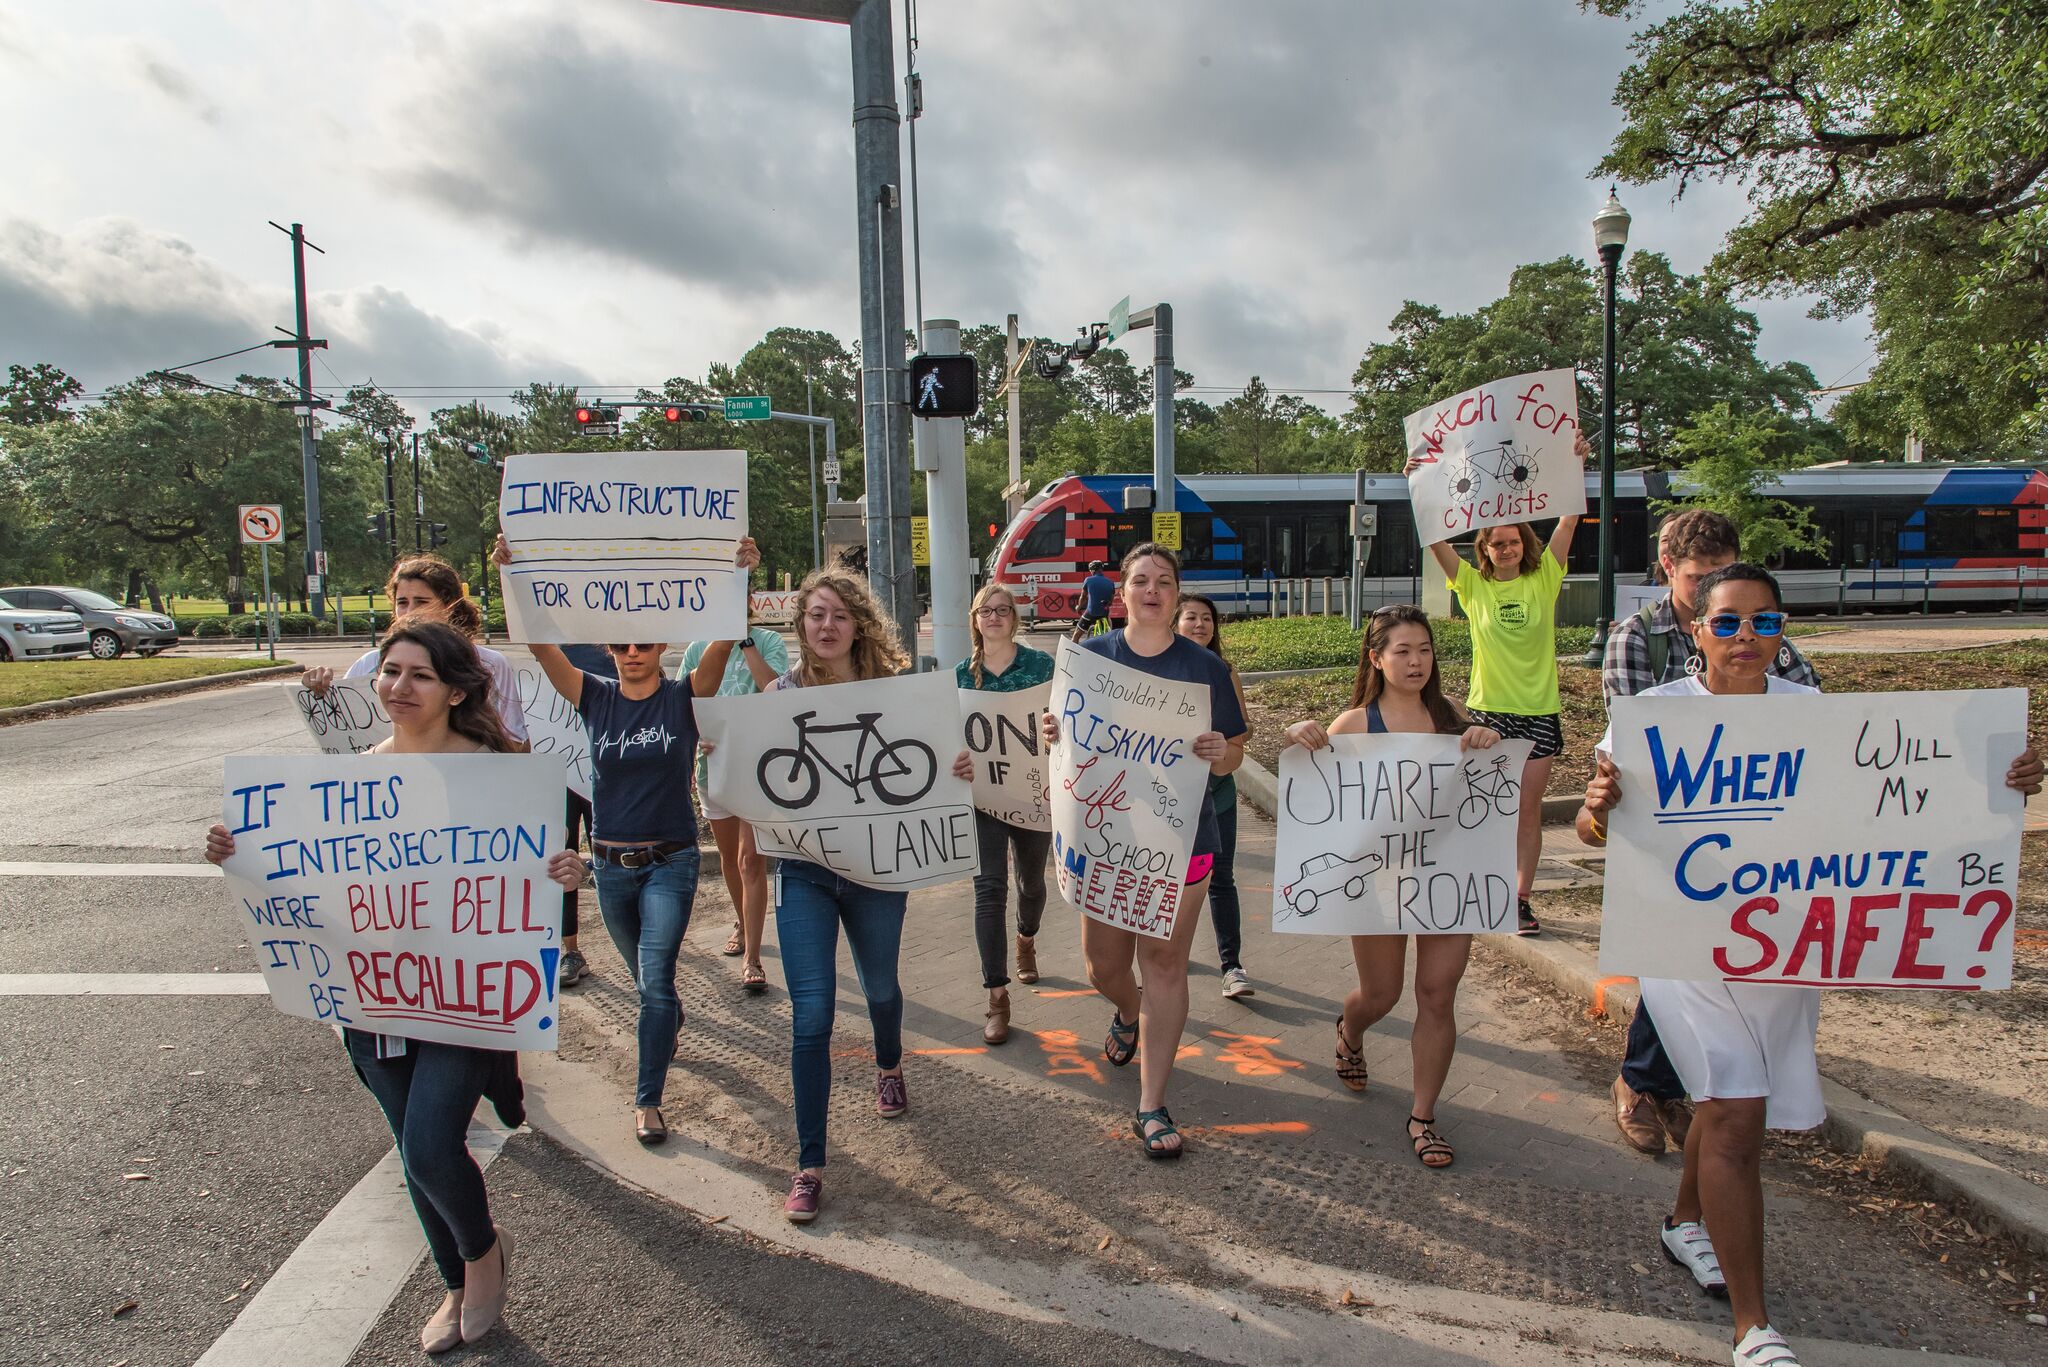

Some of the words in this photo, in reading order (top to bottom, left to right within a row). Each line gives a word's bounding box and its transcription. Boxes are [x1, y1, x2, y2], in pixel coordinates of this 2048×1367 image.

[727, 401, 753, 409] Fannin
[1516, 383, 1576, 435] for
[506, 481, 739, 520] INFRASTRUCTURE
[1444, 487, 1548, 529] cyclists
[532, 581, 572, 607] FOR
[584, 577, 707, 612] CYCLISTS
[1022, 574, 1060, 582] METRO
[1060, 648, 1081, 678] I
[1088, 671, 1169, 711] shouldn't
[1177, 692, 1197, 717] be
[1062, 688, 1184, 767] RISKING
[988, 761, 1010, 785] IF
[1064, 756, 1131, 829] Life
[1151, 776, 1168, 793] to
[1286, 743, 1455, 826] SHARE
[1644, 723, 1804, 809] WHEN
[1855, 719, 1952, 770] WILL
[232, 783, 285, 835] IF
[310, 776, 403, 825] THIS
[1153, 796, 1178, 817] go
[1167, 812, 1183, 828] to
[262, 824, 547, 881] INTERSECTION
[868, 812, 972, 875] LANE
[1084, 822, 1177, 879] SCHOOL
[1380, 829, 1437, 870] THE
[1674, 833, 1928, 901] COMMUTE
[1957, 853, 2005, 888] BE
[244, 895, 325, 930] WERE
[347, 880, 431, 933] BLUE
[452, 875, 554, 940] BELL,
[1055, 830, 1179, 937] AMERICA
[1397, 872, 1510, 930] ROAD
[262, 940, 330, 978] IT'D
[1712, 889, 2013, 980] SAFE?
[309, 983, 353, 1023] BE
[347, 947, 560, 1030] RECALLED!
